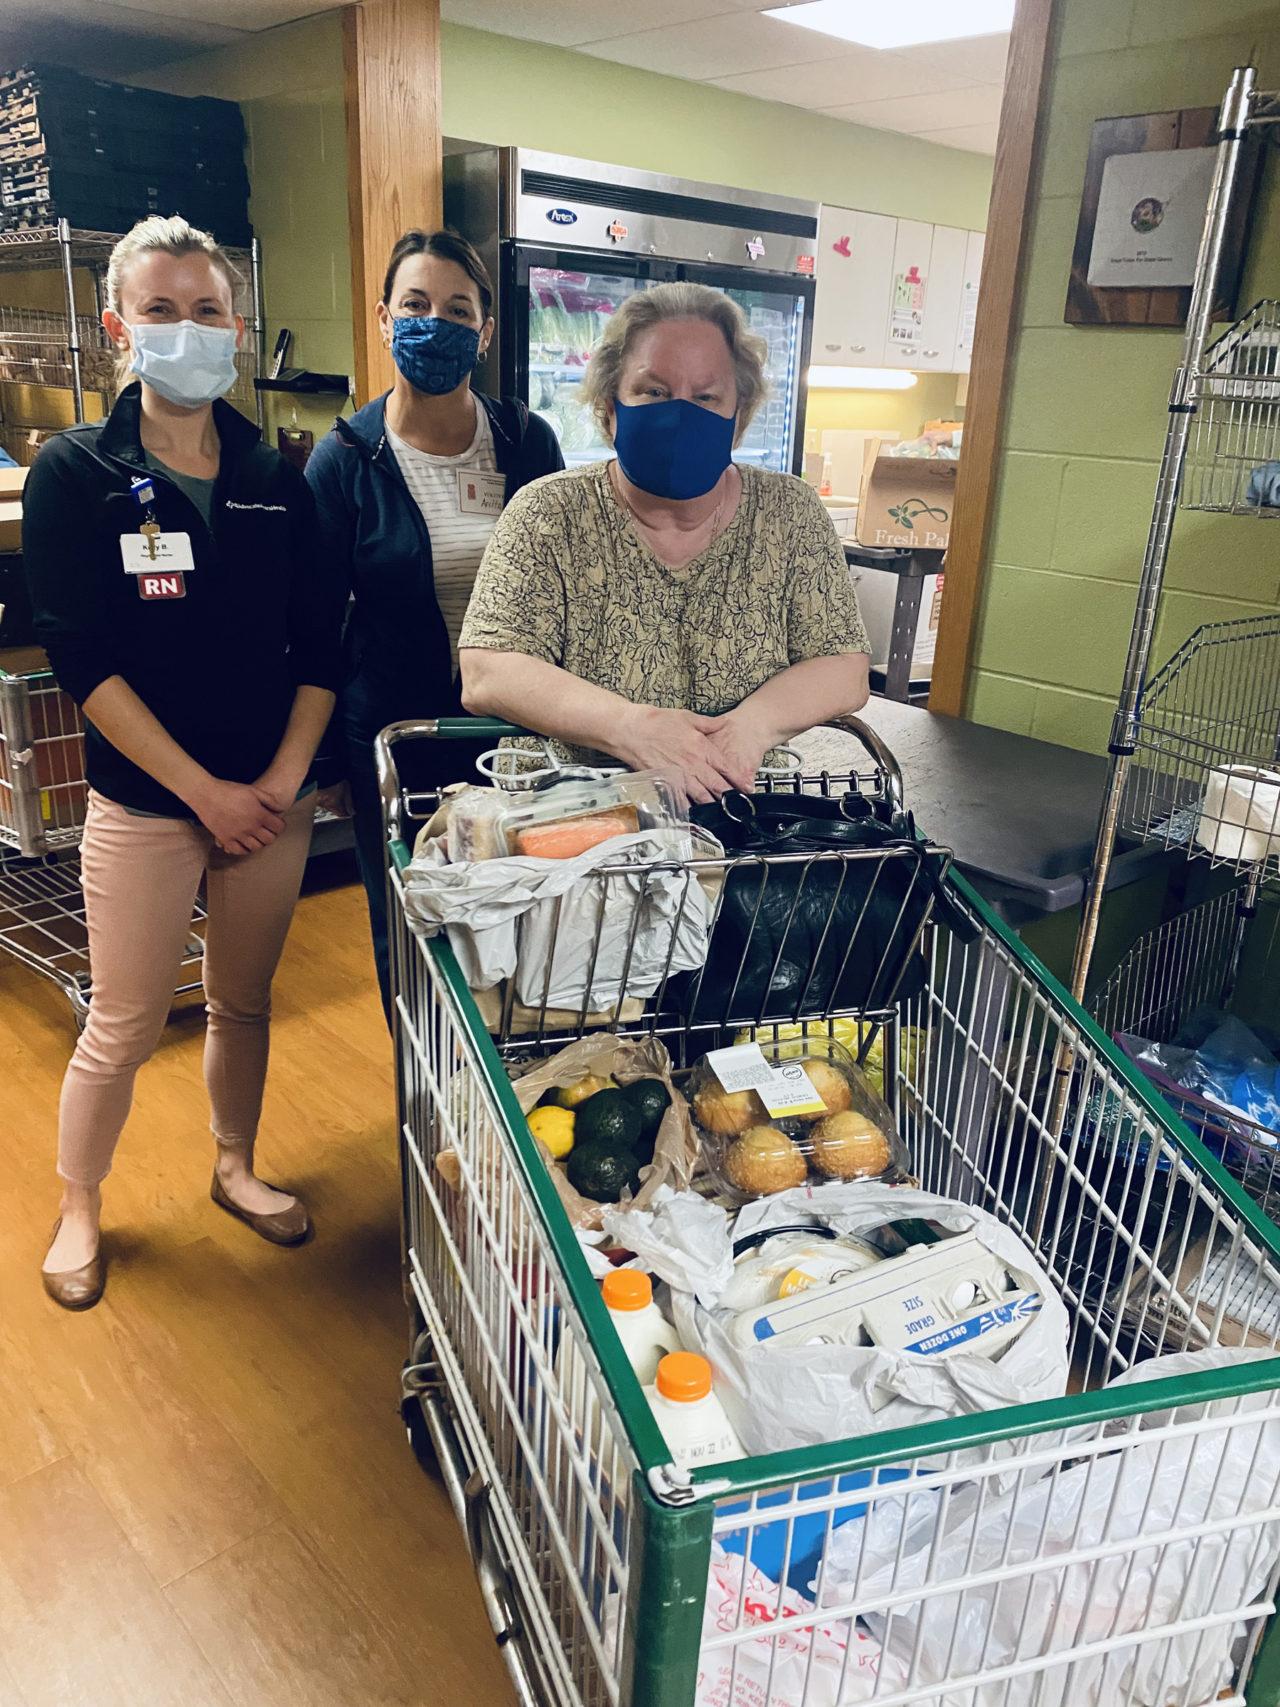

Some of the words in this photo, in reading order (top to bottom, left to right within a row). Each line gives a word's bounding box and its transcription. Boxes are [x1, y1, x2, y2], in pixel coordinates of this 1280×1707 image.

[873, 529, 918, 545] Fresh
[144, 578, 178, 595] RN
[902, 1295, 924, 1312] SIZE
[908, 1316, 935, 1335] GRADE
[950, 1325, 967, 1341] ONE
[919, 1329, 949, 1352] DOZEN
